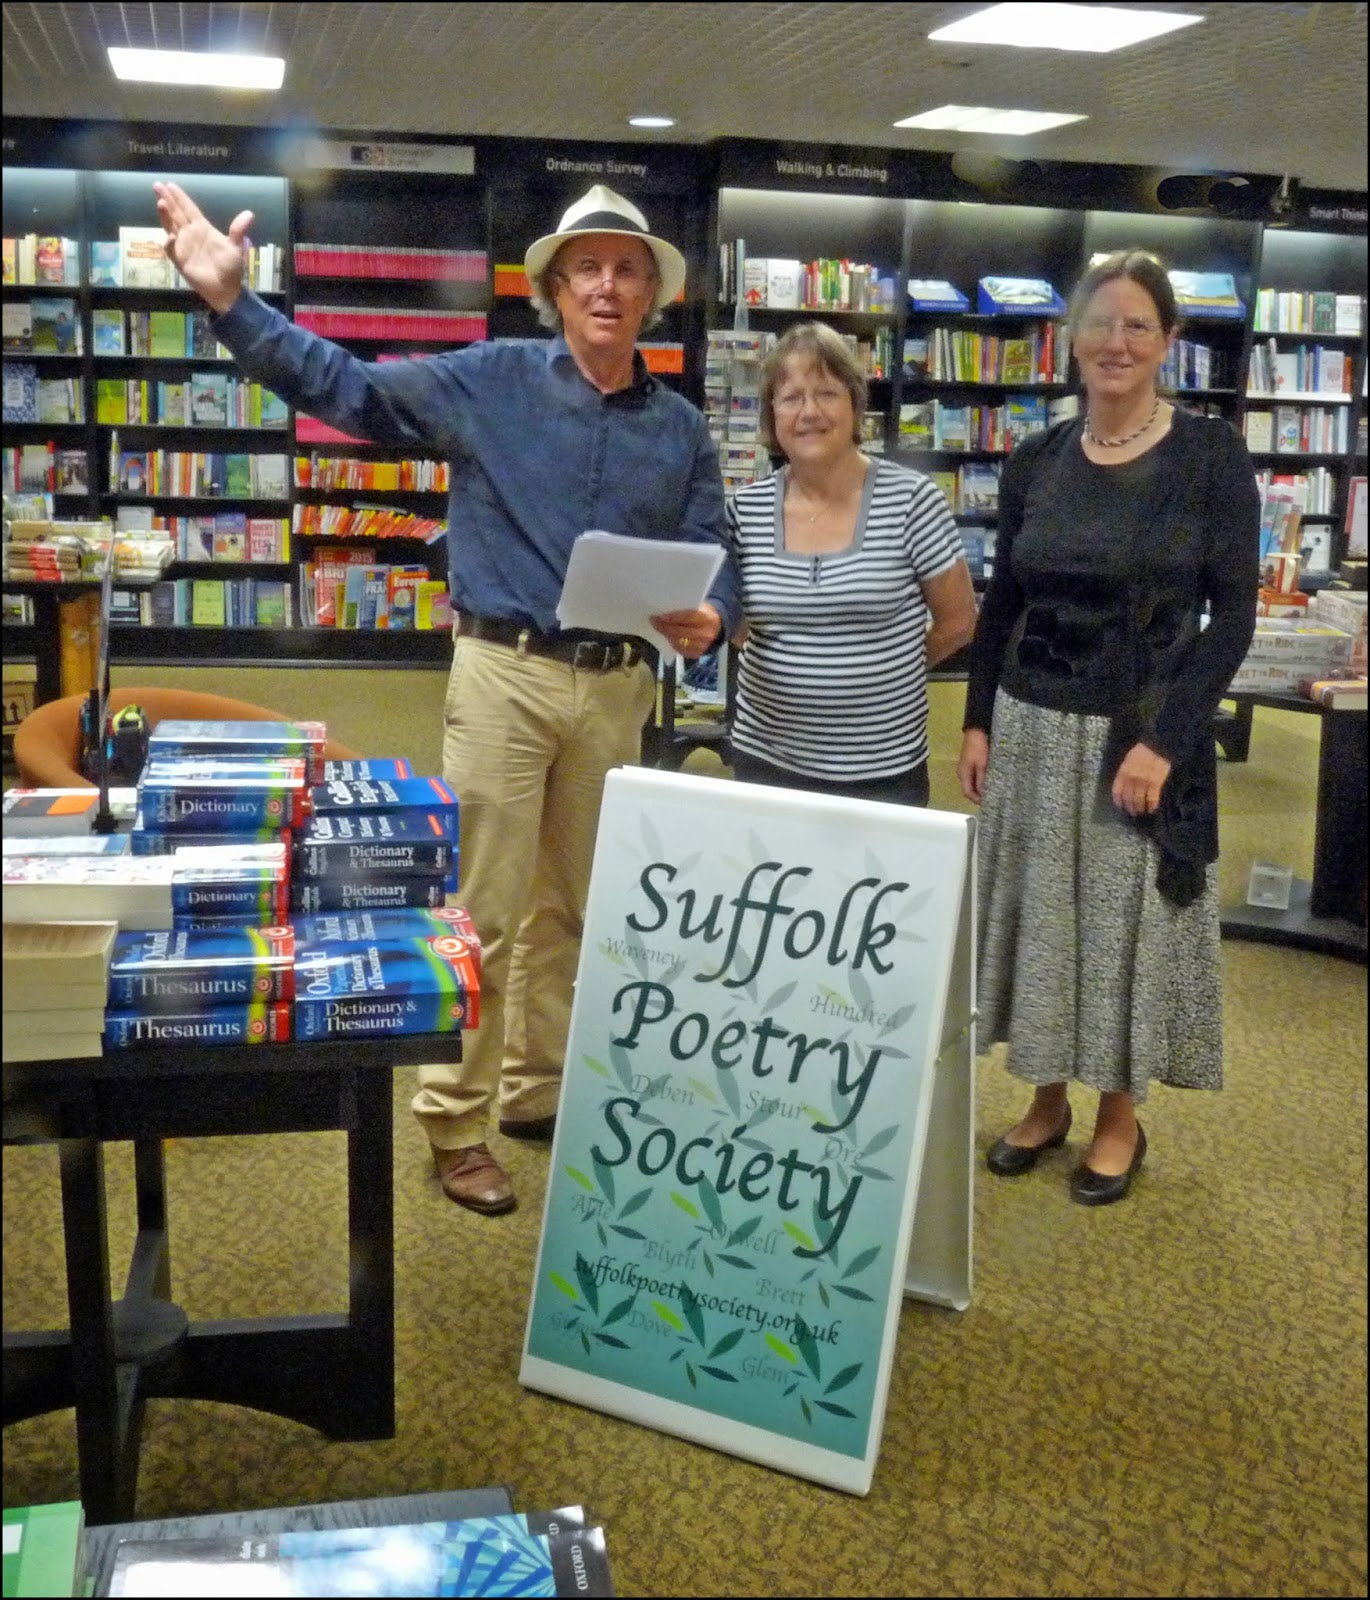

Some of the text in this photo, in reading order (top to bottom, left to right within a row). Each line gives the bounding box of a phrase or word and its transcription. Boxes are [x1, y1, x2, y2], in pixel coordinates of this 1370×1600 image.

[127, 140, 229, 157] Travel Literature
[545, 157, 648, 177] Ordnance Survey
[776, 160, 888, 183] Walking & Climbing
[1310, 206, 1339, 219] Smart
[181, 799, 258, 815] Dictionary
[349, 846, 414, 859] Dictionary
[350, 857, 414, 869] & Thesaurus
[188, 891, 256, 905] Dictionary
[342, 884, 407, 898] Dictionary
[354, 896, 407, 908] Thesaurus
[625, 861, 911, 989] Suffolk
[606, 937, 681, 974] Waveney
[302, 951, 332, 994] Oxfod
[135, 975, 248, 997] Thesaurus
[325, 1000, 418, 1019] Dictionary &
[130, 1019, 242, 1039] Thesaurus
[324, 1015, 405, 1032] Thesaurus
[610, 980, 883, 1134] Poetry
[745, 1089, 808, 1120] Stour
[590, 1096, 864, 1258] Society
[642, 1239, 697, 1273] Blyth
[755, 1278, 806, 1307] Brett
[570, 1544, 589, 1591] OXFORD
